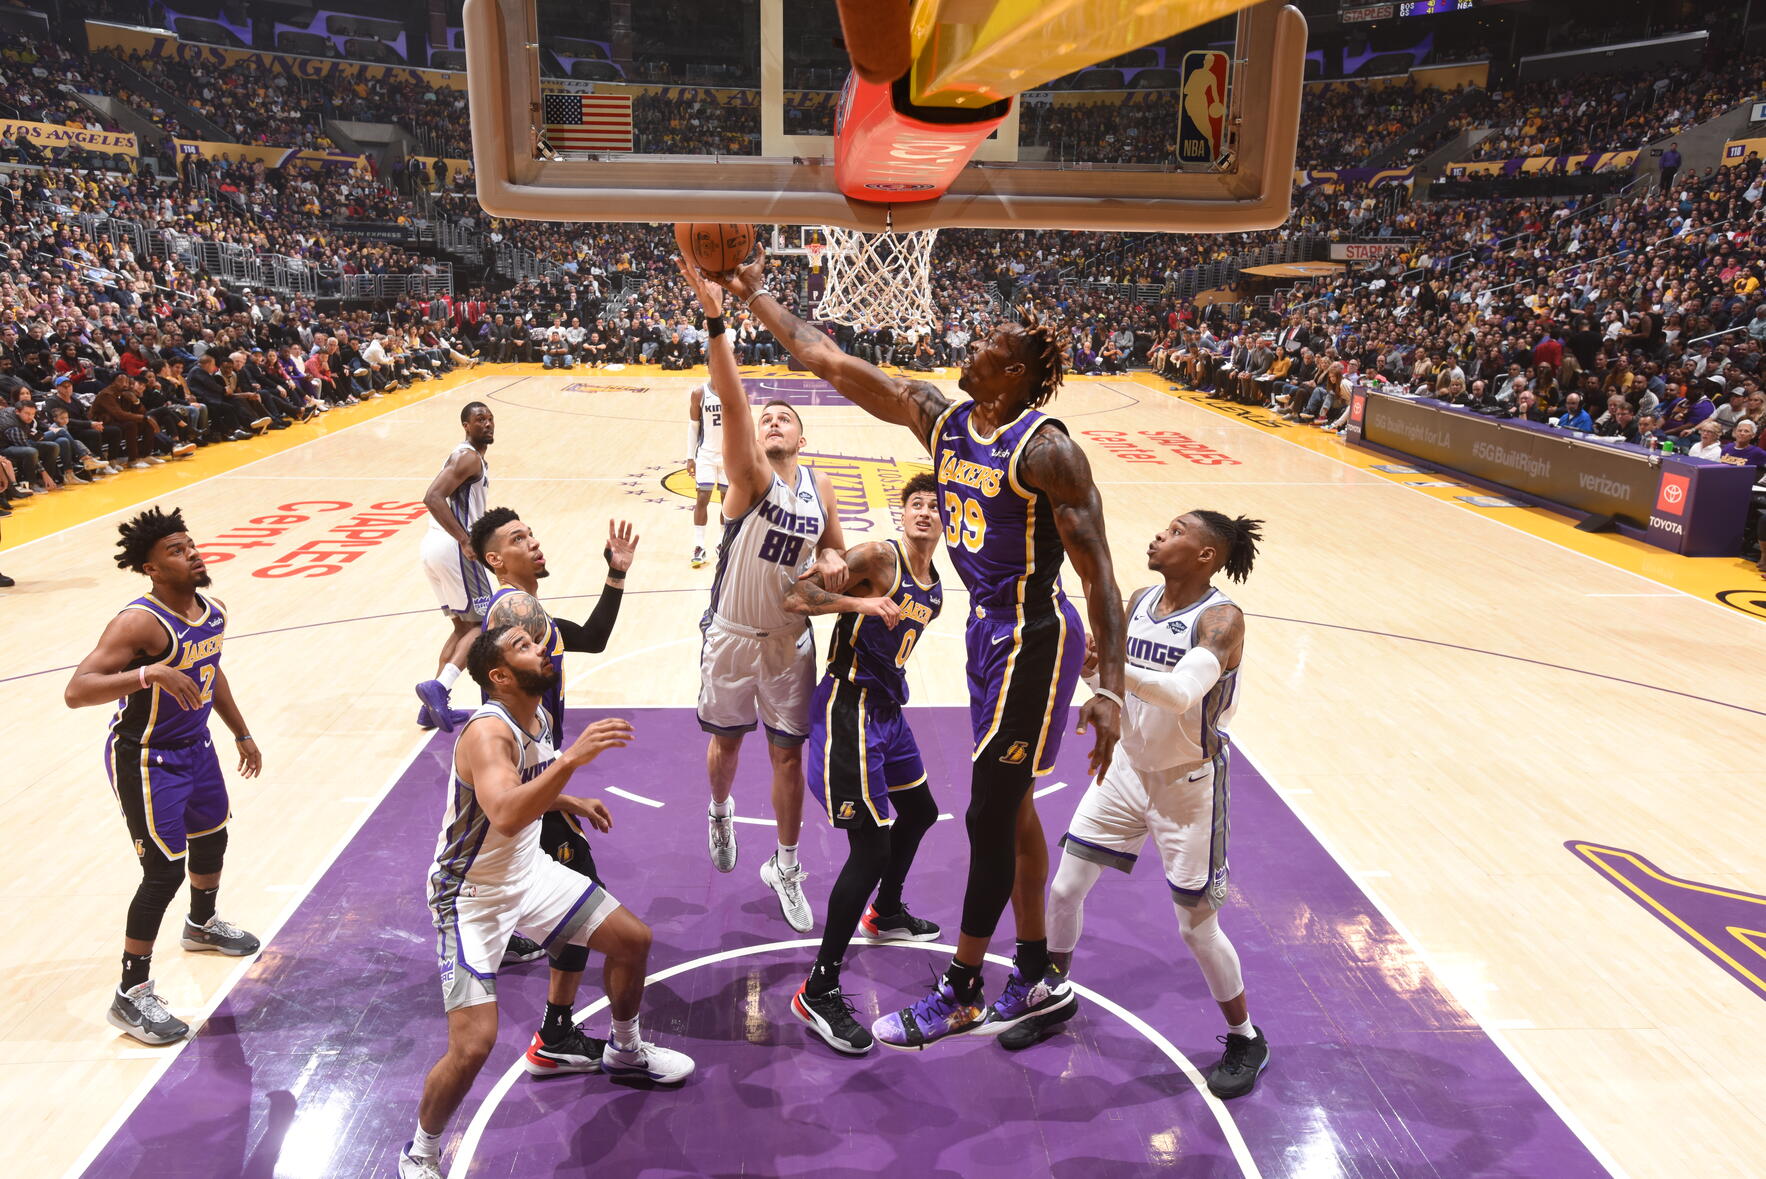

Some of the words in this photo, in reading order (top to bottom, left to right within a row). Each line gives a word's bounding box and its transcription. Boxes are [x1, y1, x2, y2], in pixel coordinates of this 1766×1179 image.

[1343, 6, 1392, 22] STAPLES
[45, 129, 136, 149] ANGELES
[1183, 139, 1205, 158] NBA
[704, 404, 722, 413] KIN
[1080, 430, 1169, 466] Center
[1138, 430, 1243, 466] STAPLES
[938, 448, 1005, 498] LAKERS
[1579, 472, 1631, 501] verizon
[196, 500, 354, 565] Cente
[758, 499, 820, 536] KINGS
[944, 490, 987, 554] 39
[1650, 516, 1682, 536] TOYOTA
[251, 501, 429, 579] STAPLES
[758, 528, 806, 568] 88
[894, 628, 917, 669] 0
